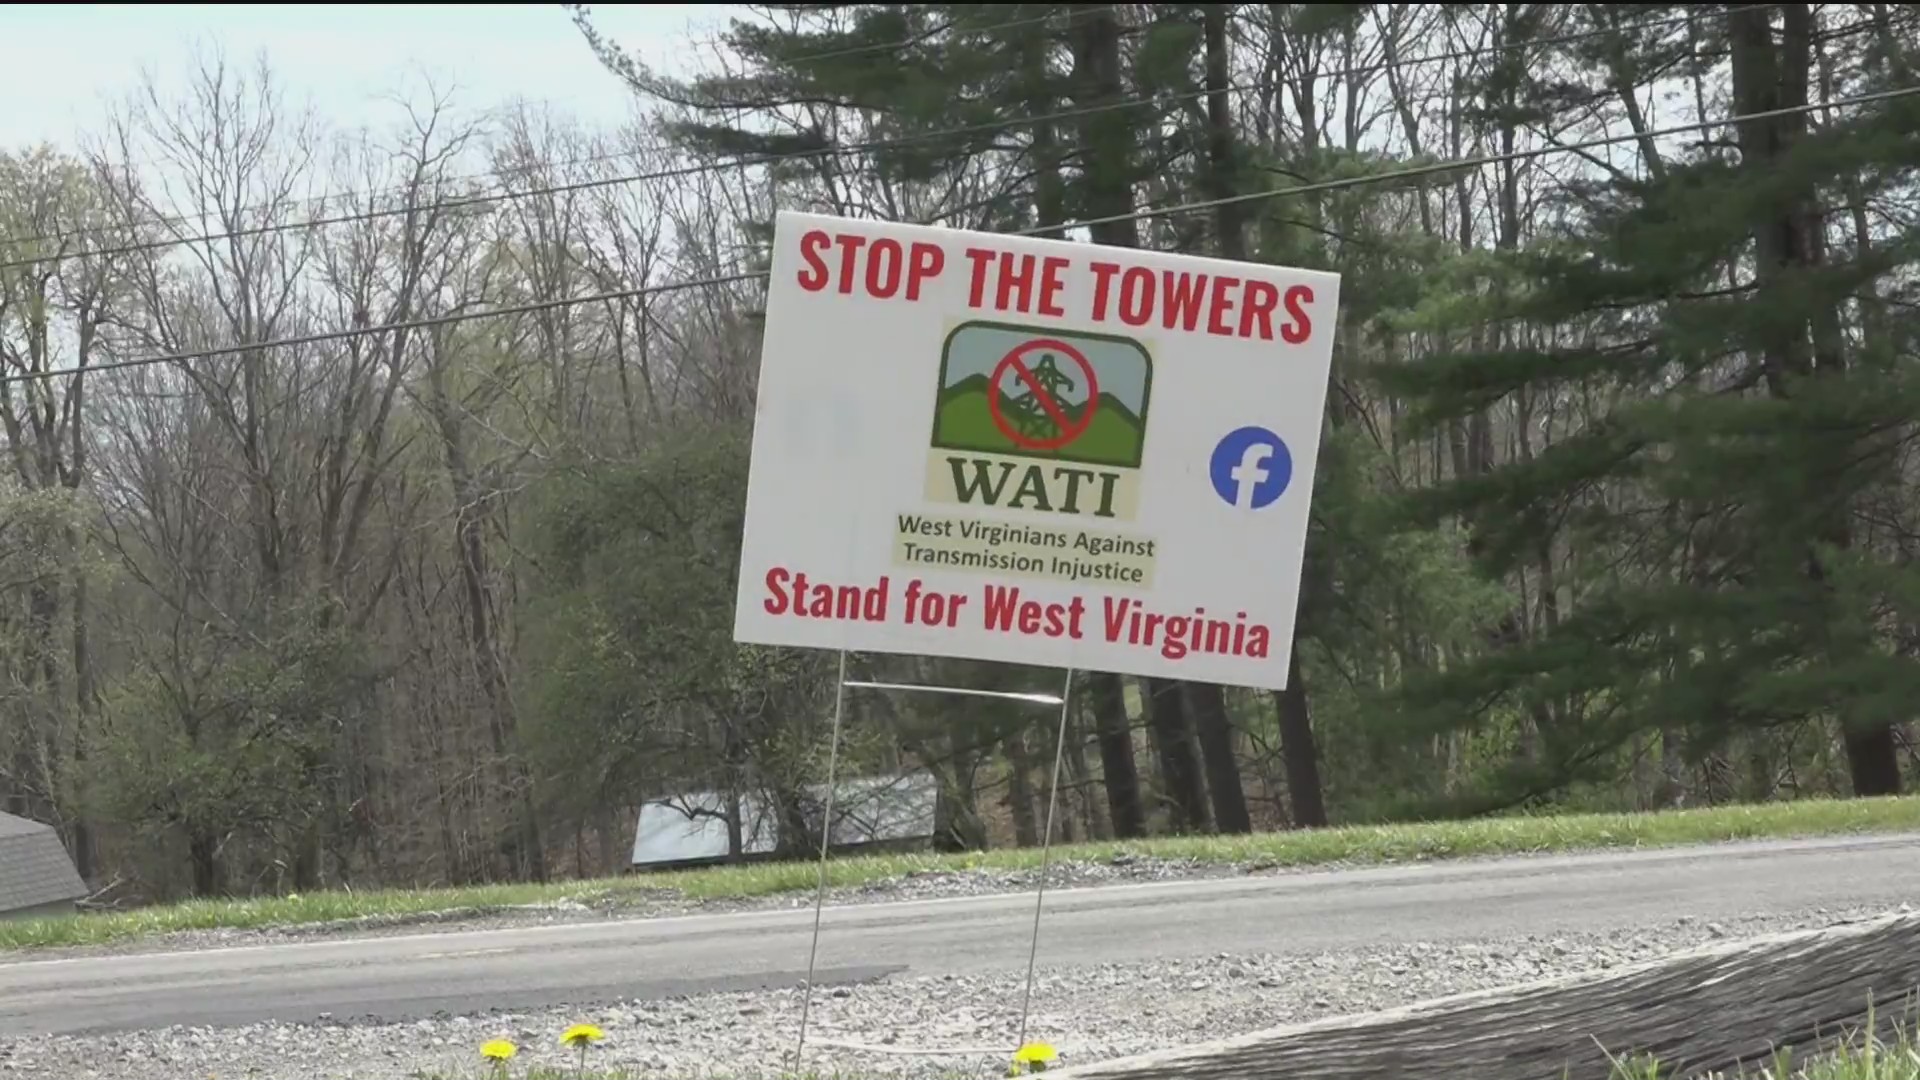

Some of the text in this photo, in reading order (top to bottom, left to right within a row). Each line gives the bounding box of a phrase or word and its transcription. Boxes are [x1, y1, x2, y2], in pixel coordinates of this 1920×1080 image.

[799, 231, 1313, 344] STOP THE TOWERS
[946, 457, 1120, 519] WATI
[897, 513, 1155, 557] West Virginians Against
[904, 542, 1143, 583] Transmission Injustice
[764, 567, 1269, 661] Stand for West Virginia
